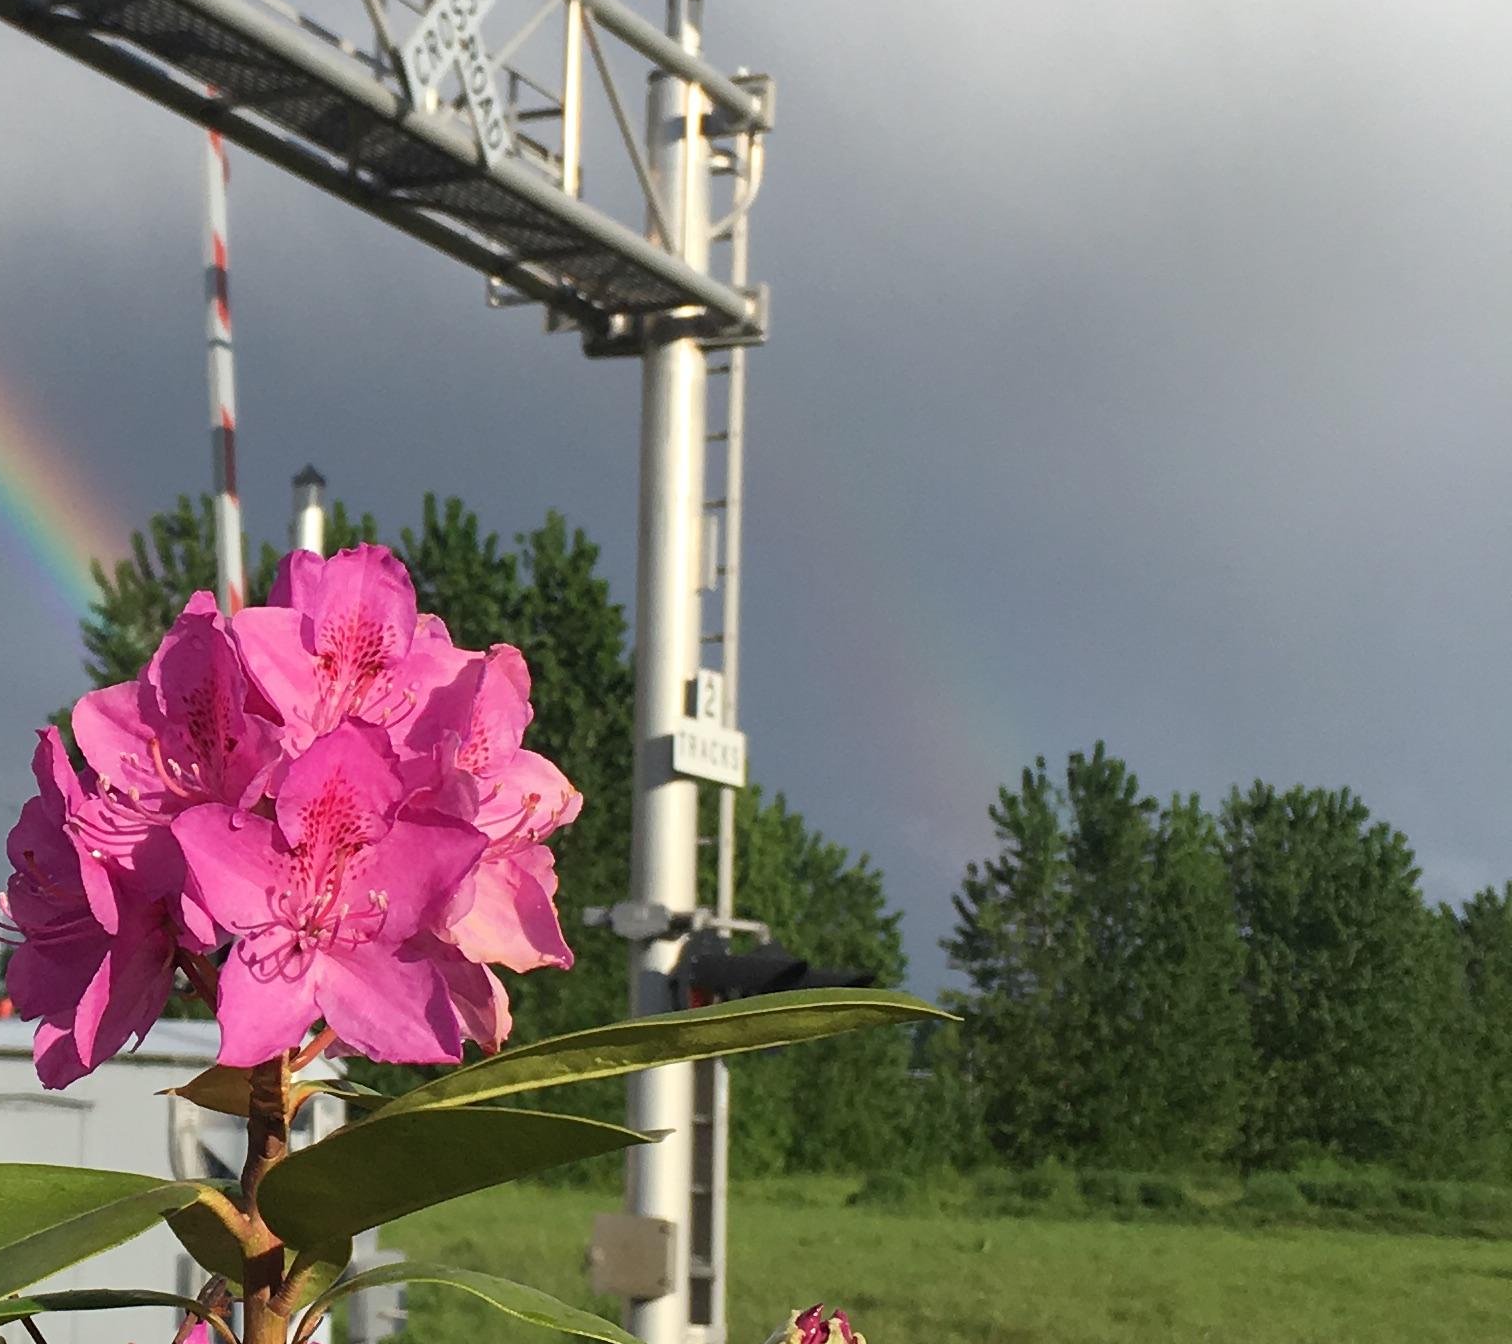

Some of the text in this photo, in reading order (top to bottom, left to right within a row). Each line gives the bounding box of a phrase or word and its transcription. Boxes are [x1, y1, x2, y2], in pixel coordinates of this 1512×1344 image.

[461, 34, 505, 152] ROAD
[703, 676, 716, 718] 2
[679, 731, 740, 771] TRACKS
